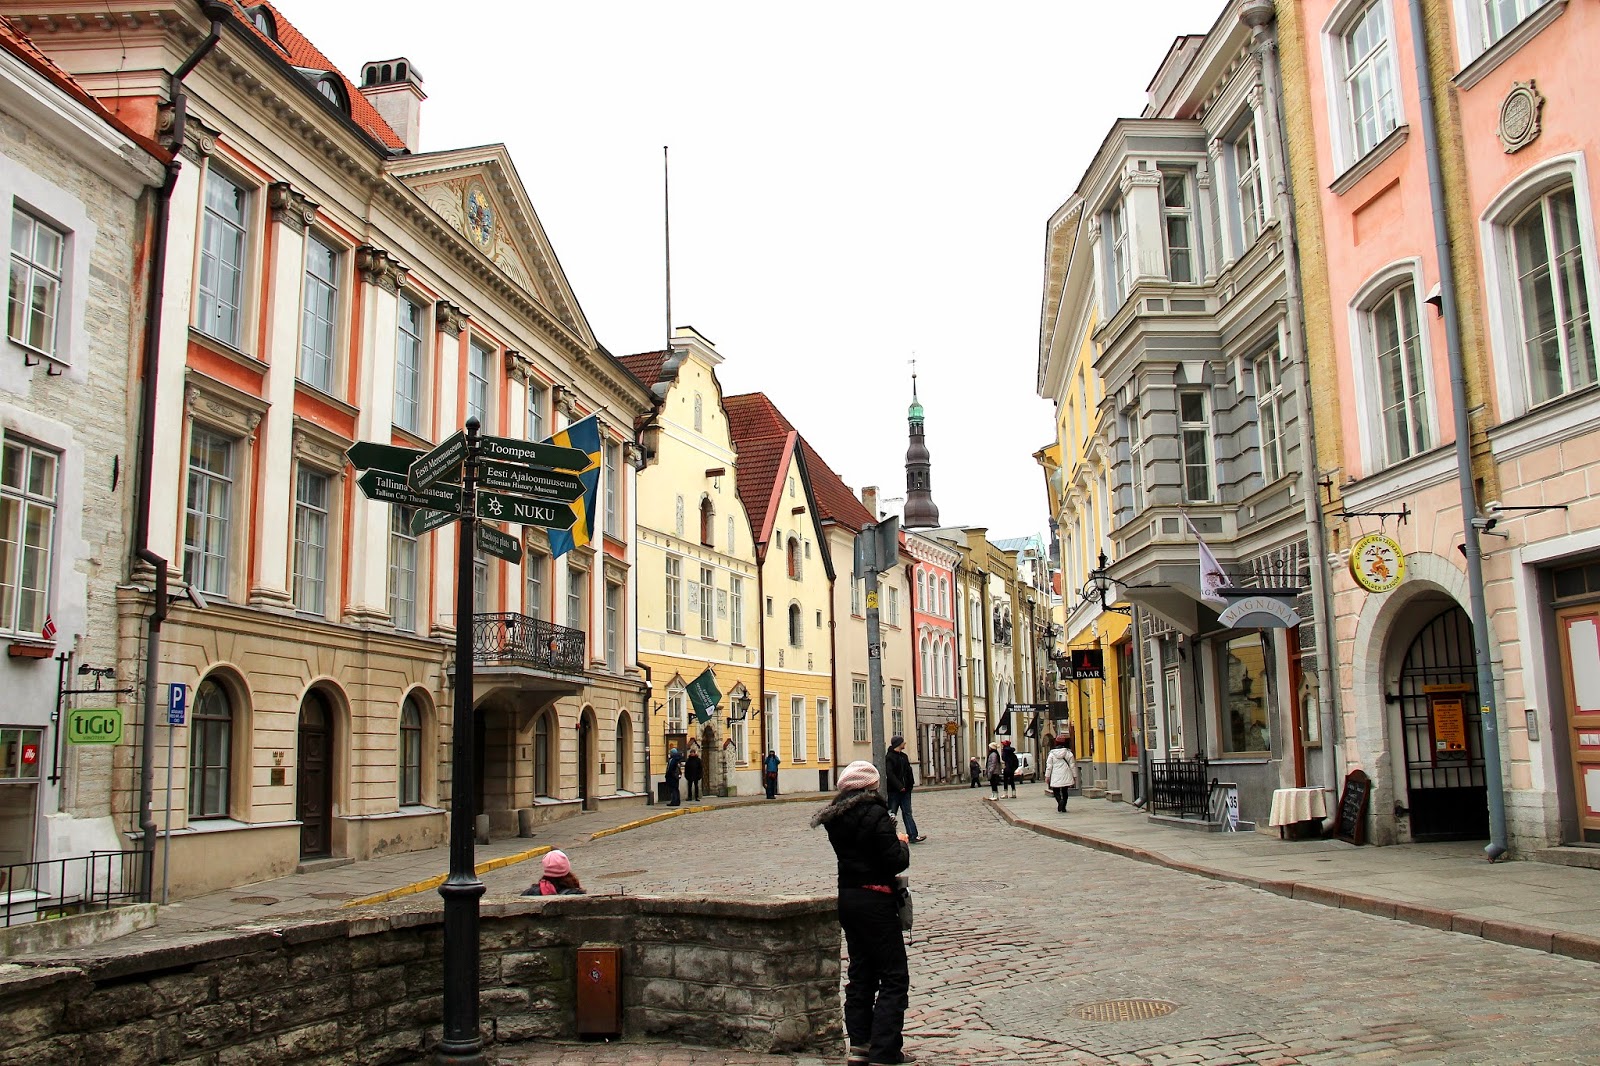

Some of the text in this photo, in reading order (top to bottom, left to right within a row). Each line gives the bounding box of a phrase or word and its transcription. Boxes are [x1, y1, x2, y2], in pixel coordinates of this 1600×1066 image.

[490, 442, 536, 459] Toompea
[375, 476, 409, 491] Tallinna
[486, 477, 558, 494] Estonian History Museum
[487, 467, 578, 489] Eesti Ajaloomuuseum
[513, 503, 555, 521] NUKU
[1225, 599, 1292, 623] MAGNUNA
[1076, 670, 1100, 678] BAAR
[173, 686, 183, 709] P
[1229, 795, 1238, 809] 35
